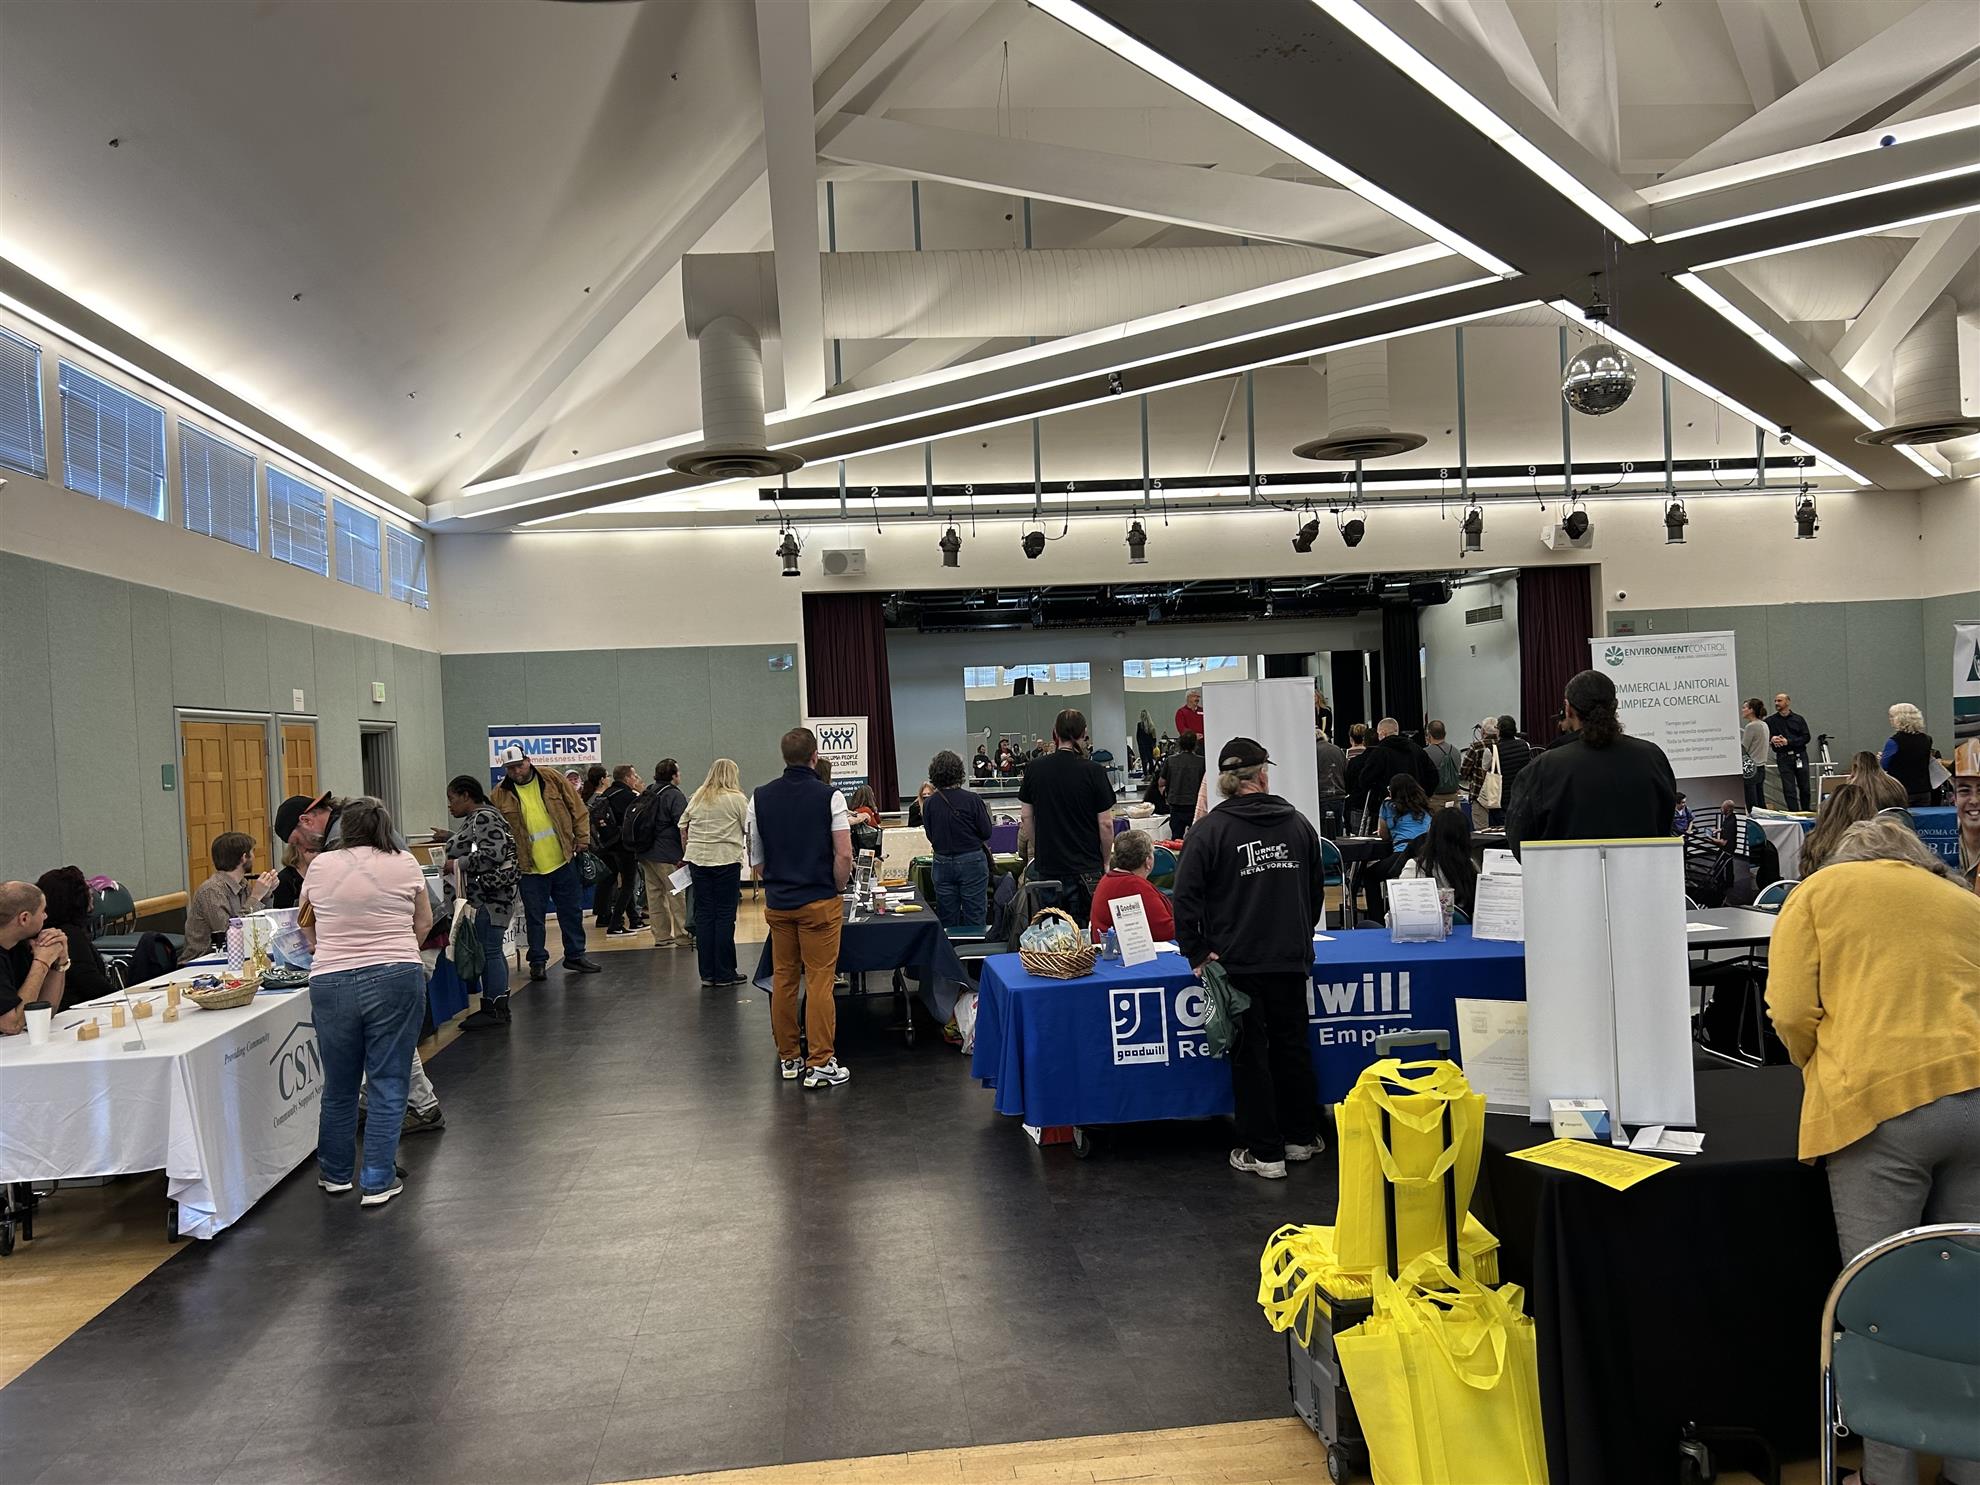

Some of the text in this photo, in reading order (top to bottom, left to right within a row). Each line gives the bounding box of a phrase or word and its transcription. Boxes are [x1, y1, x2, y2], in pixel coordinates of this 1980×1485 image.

[773, 489, 780, 499] 1
[870, 486, 879, 497] 2
[965, 484, 974, 495] 3
[1066, 481, 1075, 492] 4
[1153, 478, 1162, 488] 5
[1258, 474, 1268, 485] 6
[1341, 472, 1349, 482] 7
[1439, 468, 1448, 479] 8
[1528, 465, 1537, 476] 9
[1620, 462, 1634, 472] 10
[1708, 459, 1720, 469] 11
[1615, 678, 1730, 693] OMMERCIAL JANITORIAL
[1617, 694, 1721, 709] IMPIEZA COMERCIAL
[1918, 828, 1948, 836] ONOMA
[1240, 865, 1266, 877] METAL
[1174, 971, 1411, 1028] Gwill
[1117, 1045, 1165, 1061] goodwill
